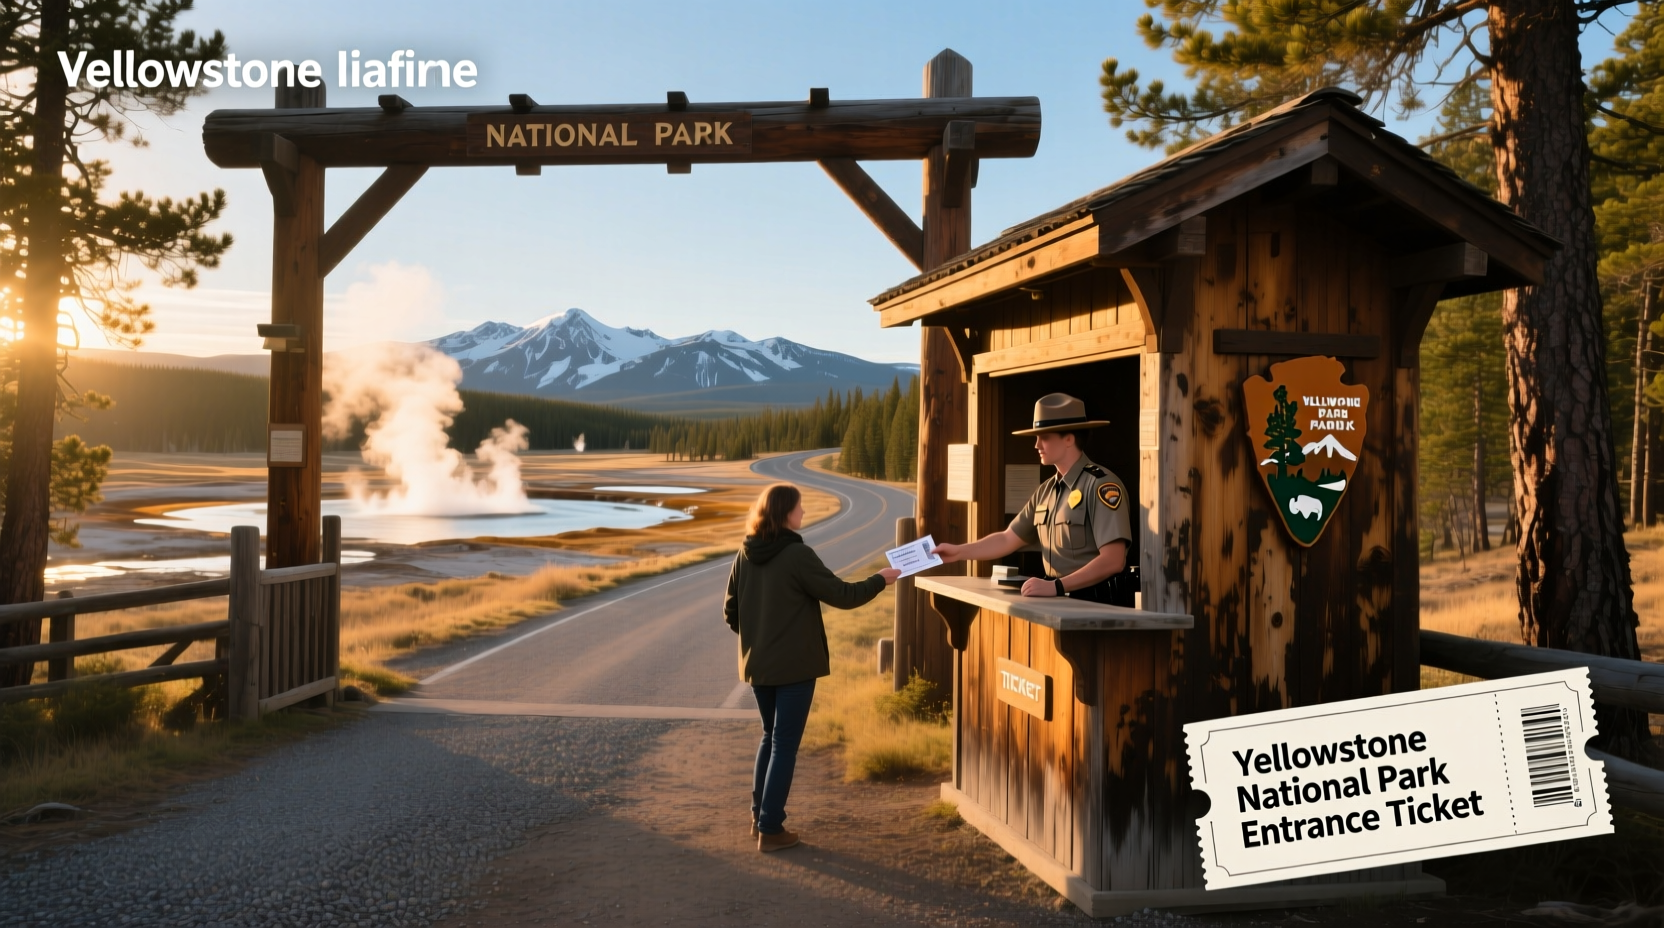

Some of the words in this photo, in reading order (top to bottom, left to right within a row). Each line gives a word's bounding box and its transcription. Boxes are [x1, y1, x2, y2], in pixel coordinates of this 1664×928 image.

[486, 123, 638, 147] NATIONAL
[655, 121, 734, 146] PARK
[1001, 670, 1042, 703] TICKET
